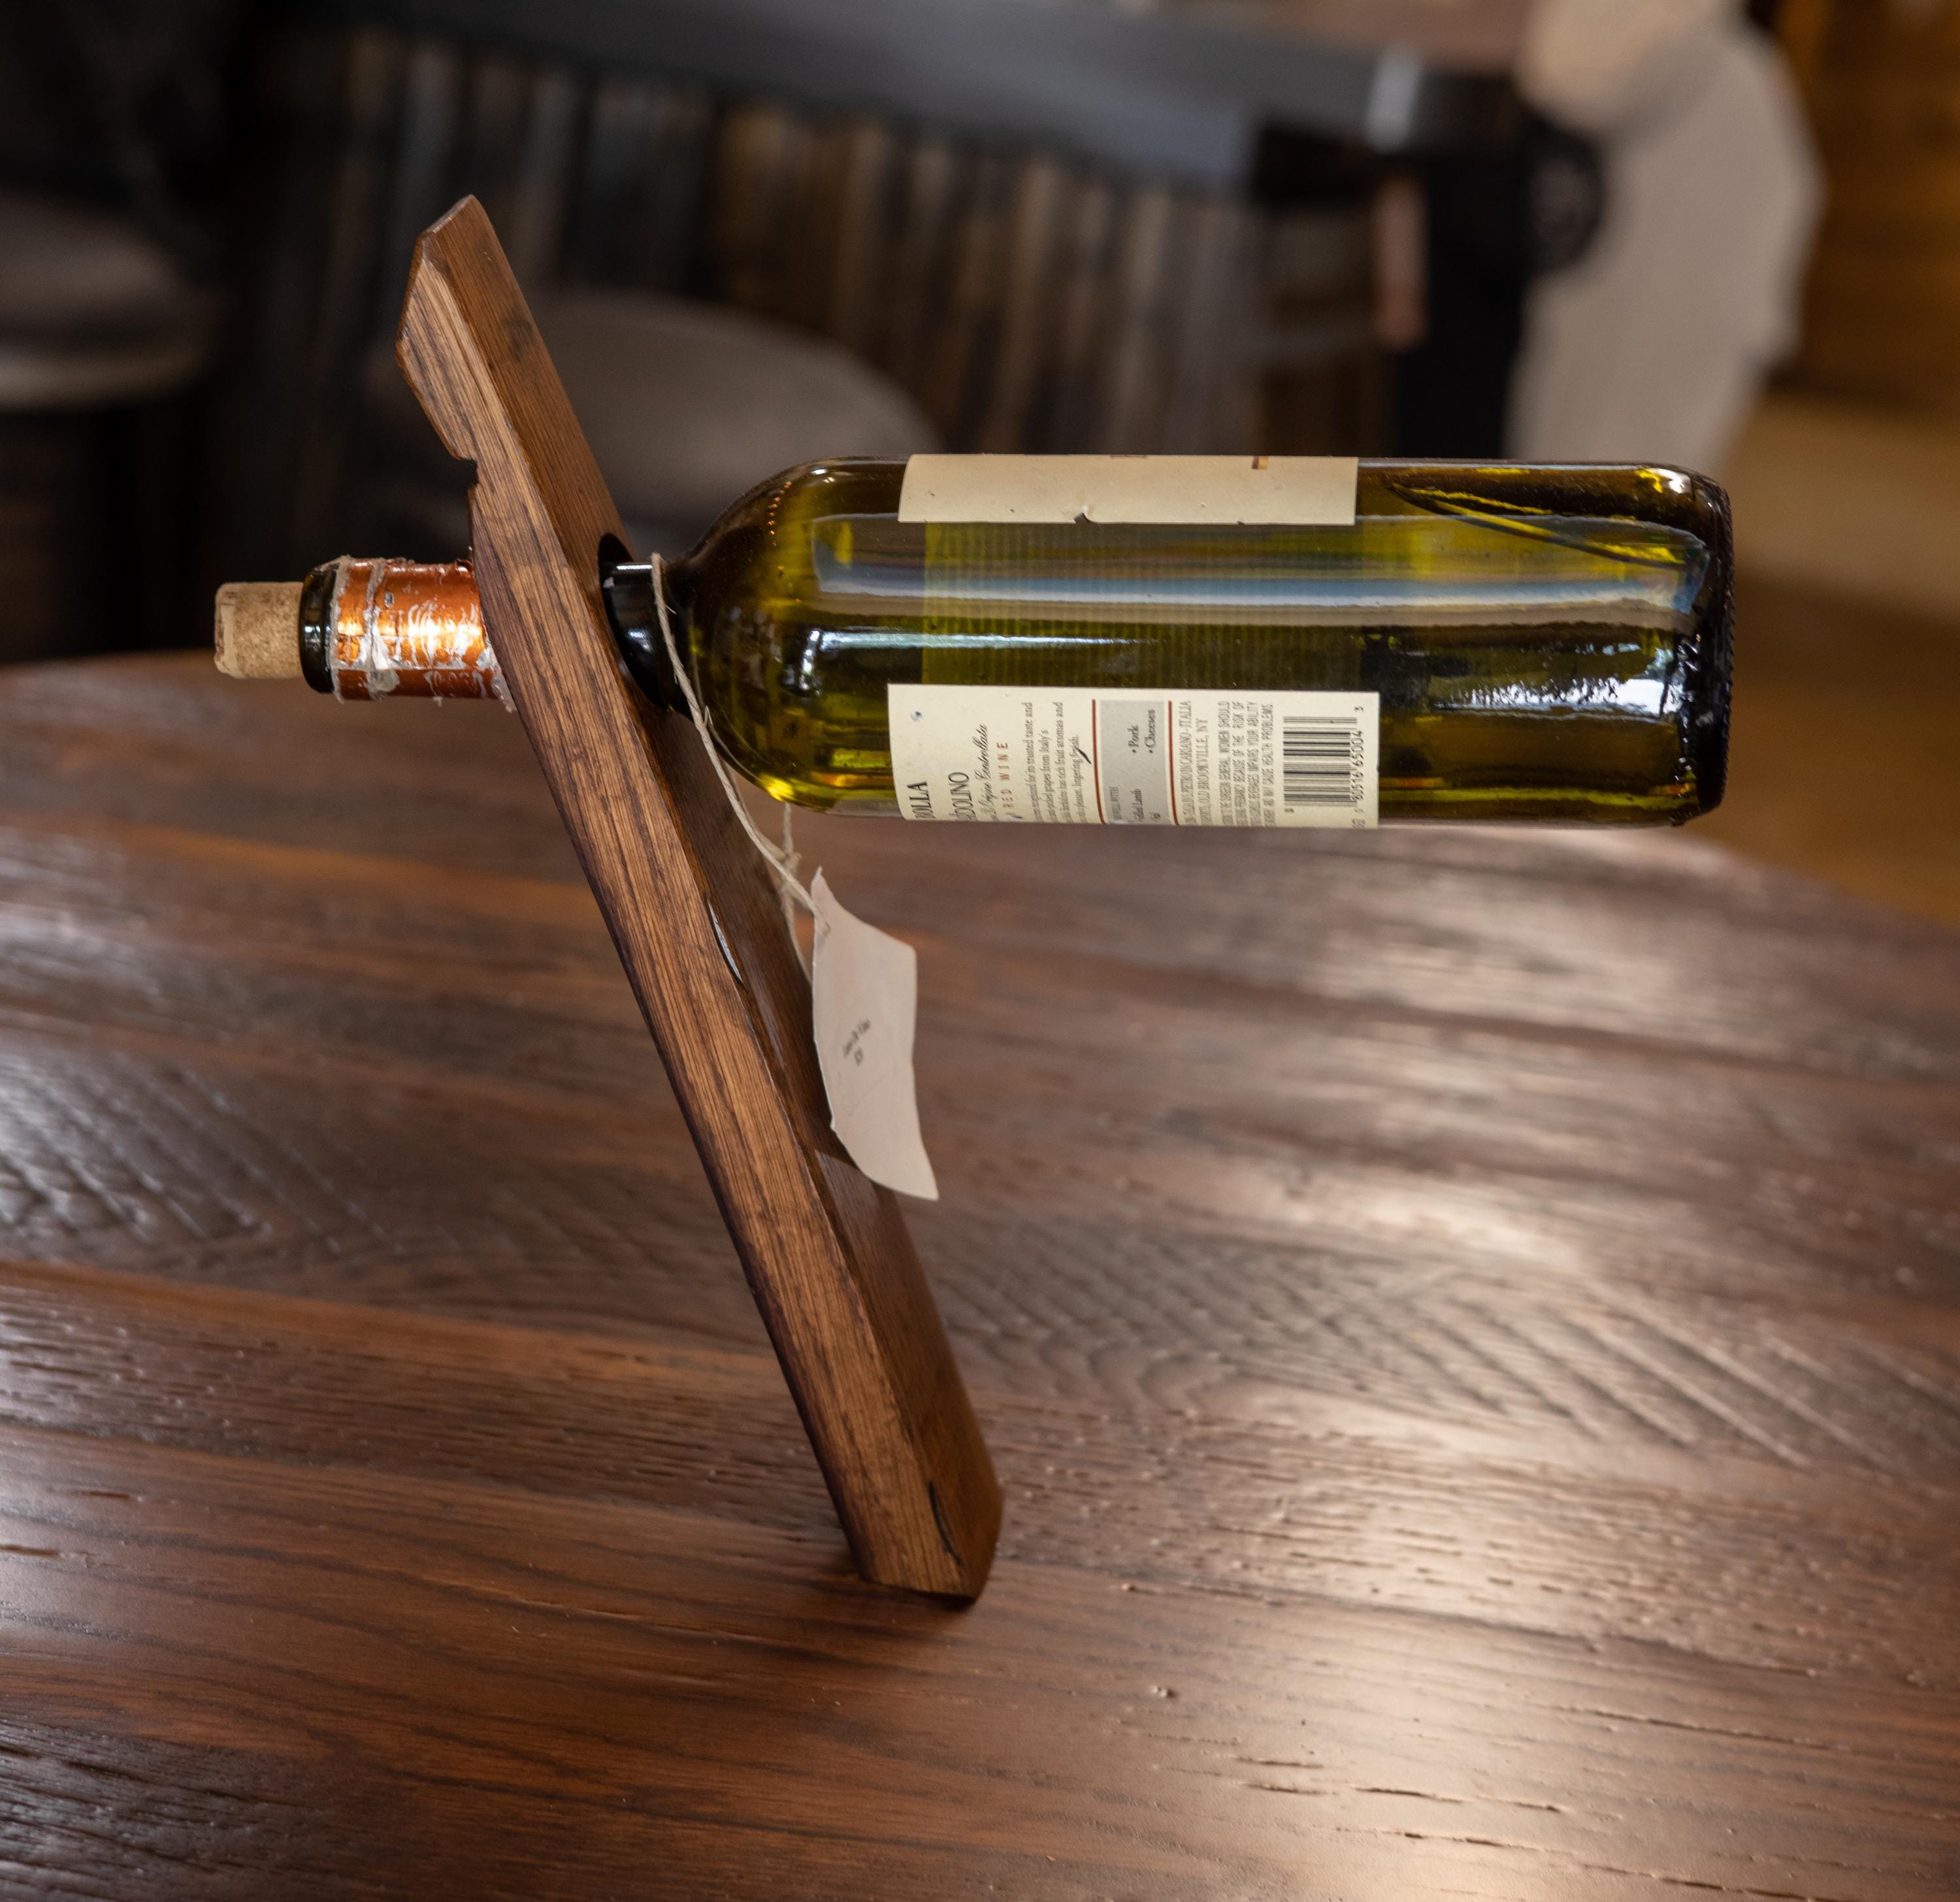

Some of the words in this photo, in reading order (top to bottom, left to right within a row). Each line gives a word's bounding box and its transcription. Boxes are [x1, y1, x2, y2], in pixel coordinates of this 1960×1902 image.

[1021, 702, 1032, 717] and
[1053, 702, 1063, 717] and
[1178, 700, 1192, 728] ITALIA
[1218, 701, 1230, 727] SHOULD
[1232, 701, 1244, 710] OF
[1247, 701, 1259, 727] ABILITY
[1023, 720, 1033, 738] taste
[1143, 710, 1156, 749] Cheeses
[1196, 717, 1208, 733] NY
[1232, 712, 1245, 729] RISK
[1037, 730, 1052, 753] Italy's
[1055, 719, 1064, 747] aromas
[1128, 725, 1139, 747] Pork
[1218, 730, 1230, 753] WOMEN
[1232, 734, 1245, 747] THE
[1247, 729, 1259, 746] YOUR
[972, 723, 991, 779] Controllata
[1022, 740, 1034, 764] trusted
[1054, 749, 1064, 765] fruit
[1261, 743, 1274, 765] HEALTH
[1350, 730, 1364, 768] 65004
[996, 742, 1010, 781] WINE
[1040, 755, 1051, 771] from
[1196, 735, 1211, 789] BROOKVILLE,
[1233, 759, 1246, 783] BECAUSE
[1247, 749, 1259, 772] IMPAIRS
[1056, 767, 1066, 779] rich
[1071, 759, 1084, 786] lingering
[1262, 768, 1274, 785] CAUSE
[1130, 789, 1143, 806] Lamb
[1198, 791, 1211, 803] OLD
[1350, 772, 1364, 801] 80516
[1000, 789, 1013, 808] RED
